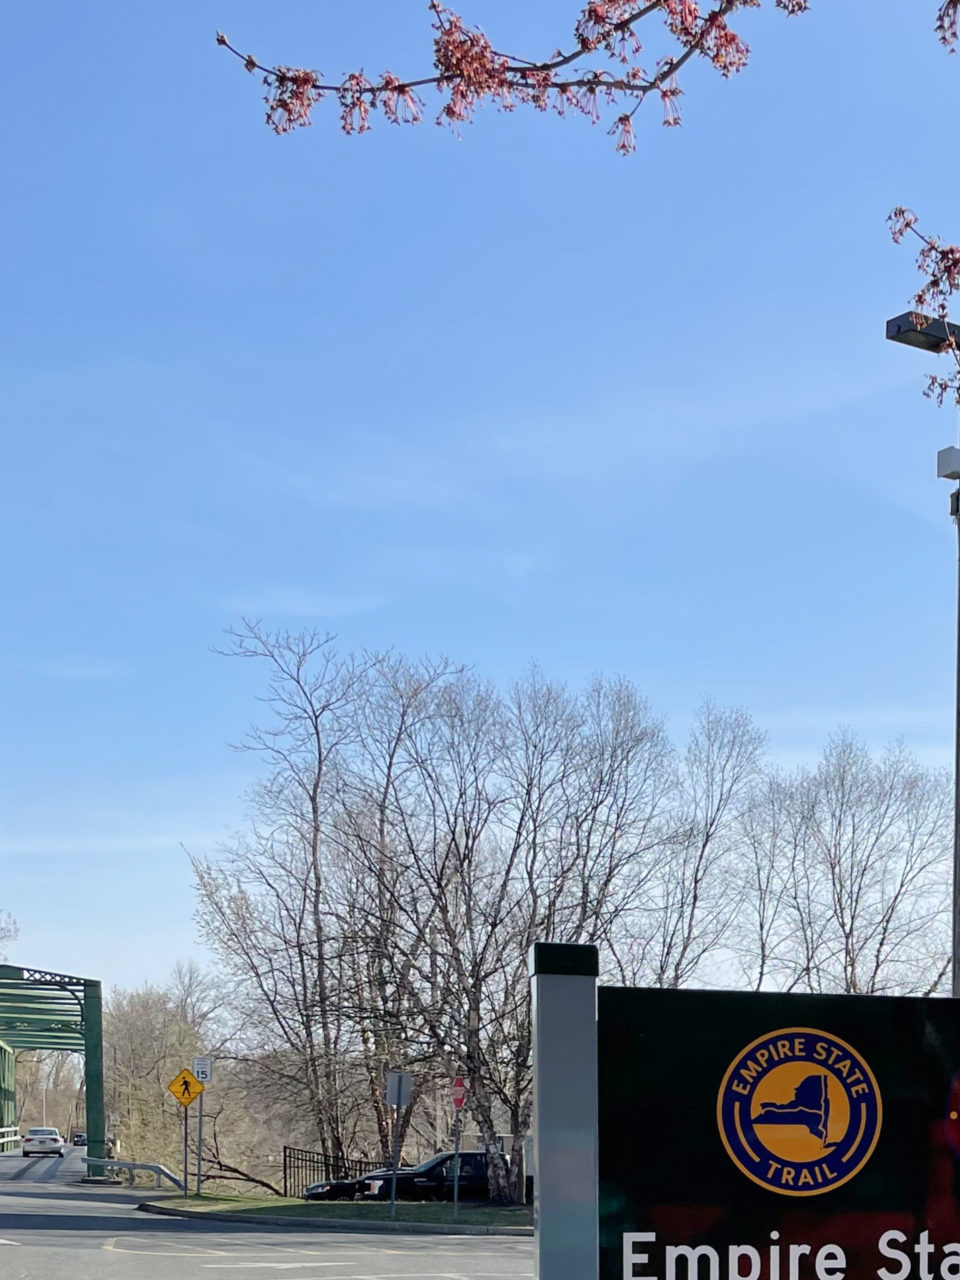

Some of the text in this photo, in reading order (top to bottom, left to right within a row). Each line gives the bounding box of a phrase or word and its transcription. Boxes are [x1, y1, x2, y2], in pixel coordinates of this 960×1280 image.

[196, 1070, 208, 1080] 15
[731, 1038, 870, 1099] EMPIRE STATE
[765, 1160, 838, 1187] TRAIL
